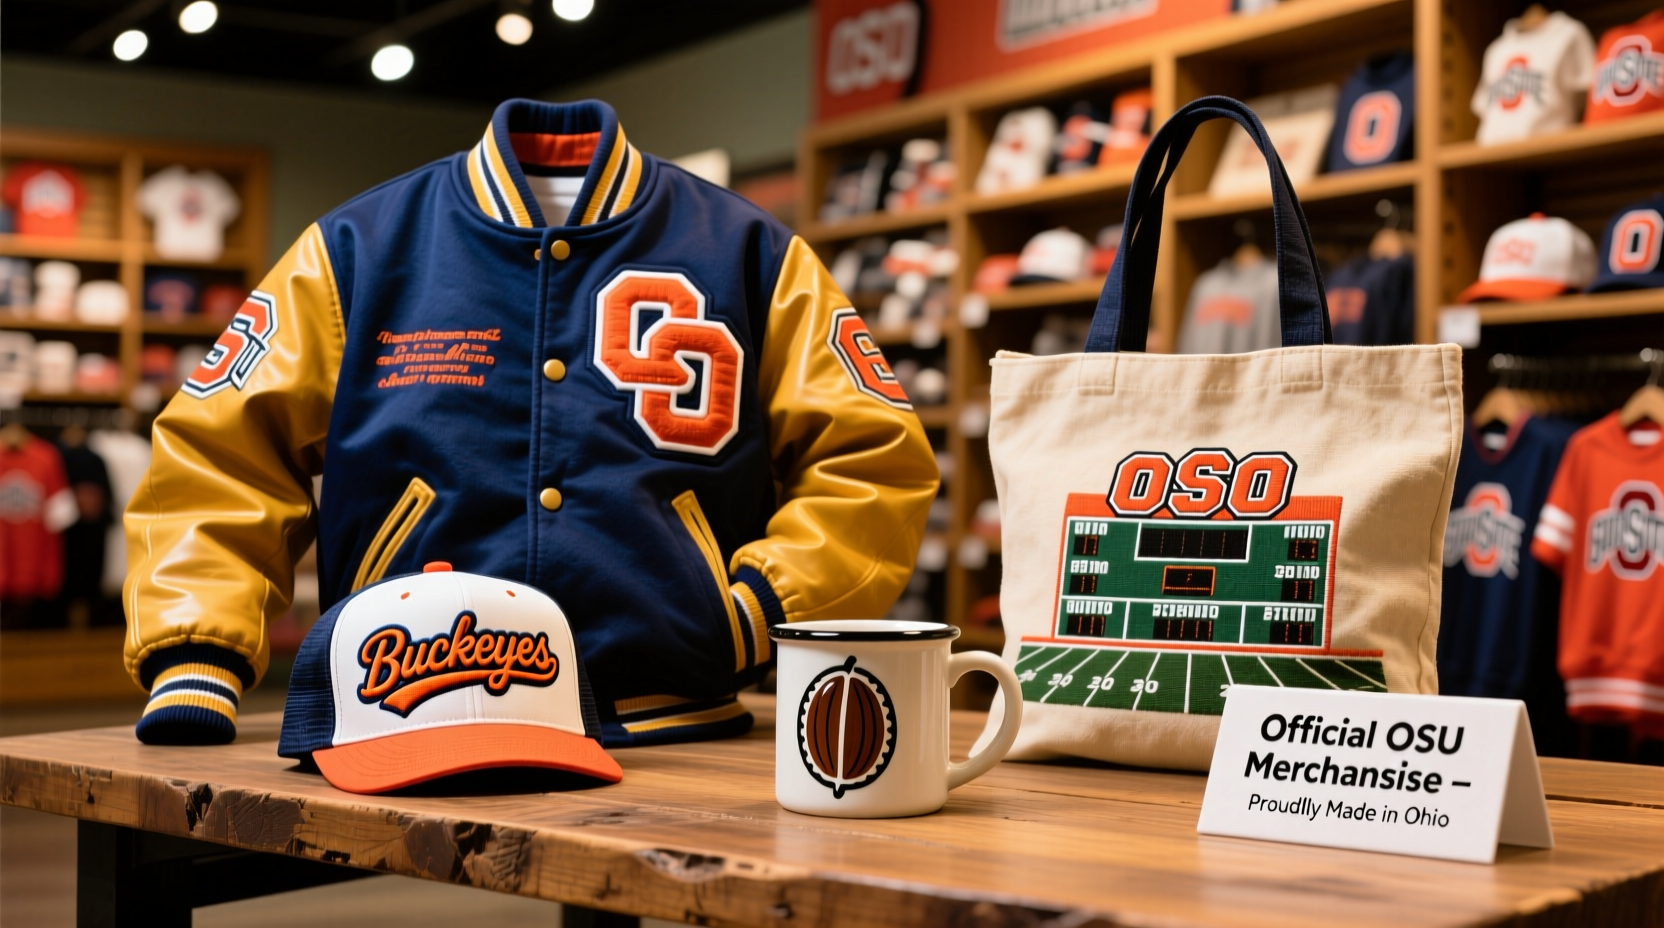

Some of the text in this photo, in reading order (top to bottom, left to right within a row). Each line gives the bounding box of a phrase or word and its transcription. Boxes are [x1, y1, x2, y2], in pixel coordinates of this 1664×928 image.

[1107, 448, 1298, 519] OSO
[358, 611, 558, 698] Buckeyes
[1261, 713, 1464, 755] Official OSU
[1244, 751, 1443, 794] Merchansise
[1248, 793, 1450, 828] Proudlly Made in Ohio
